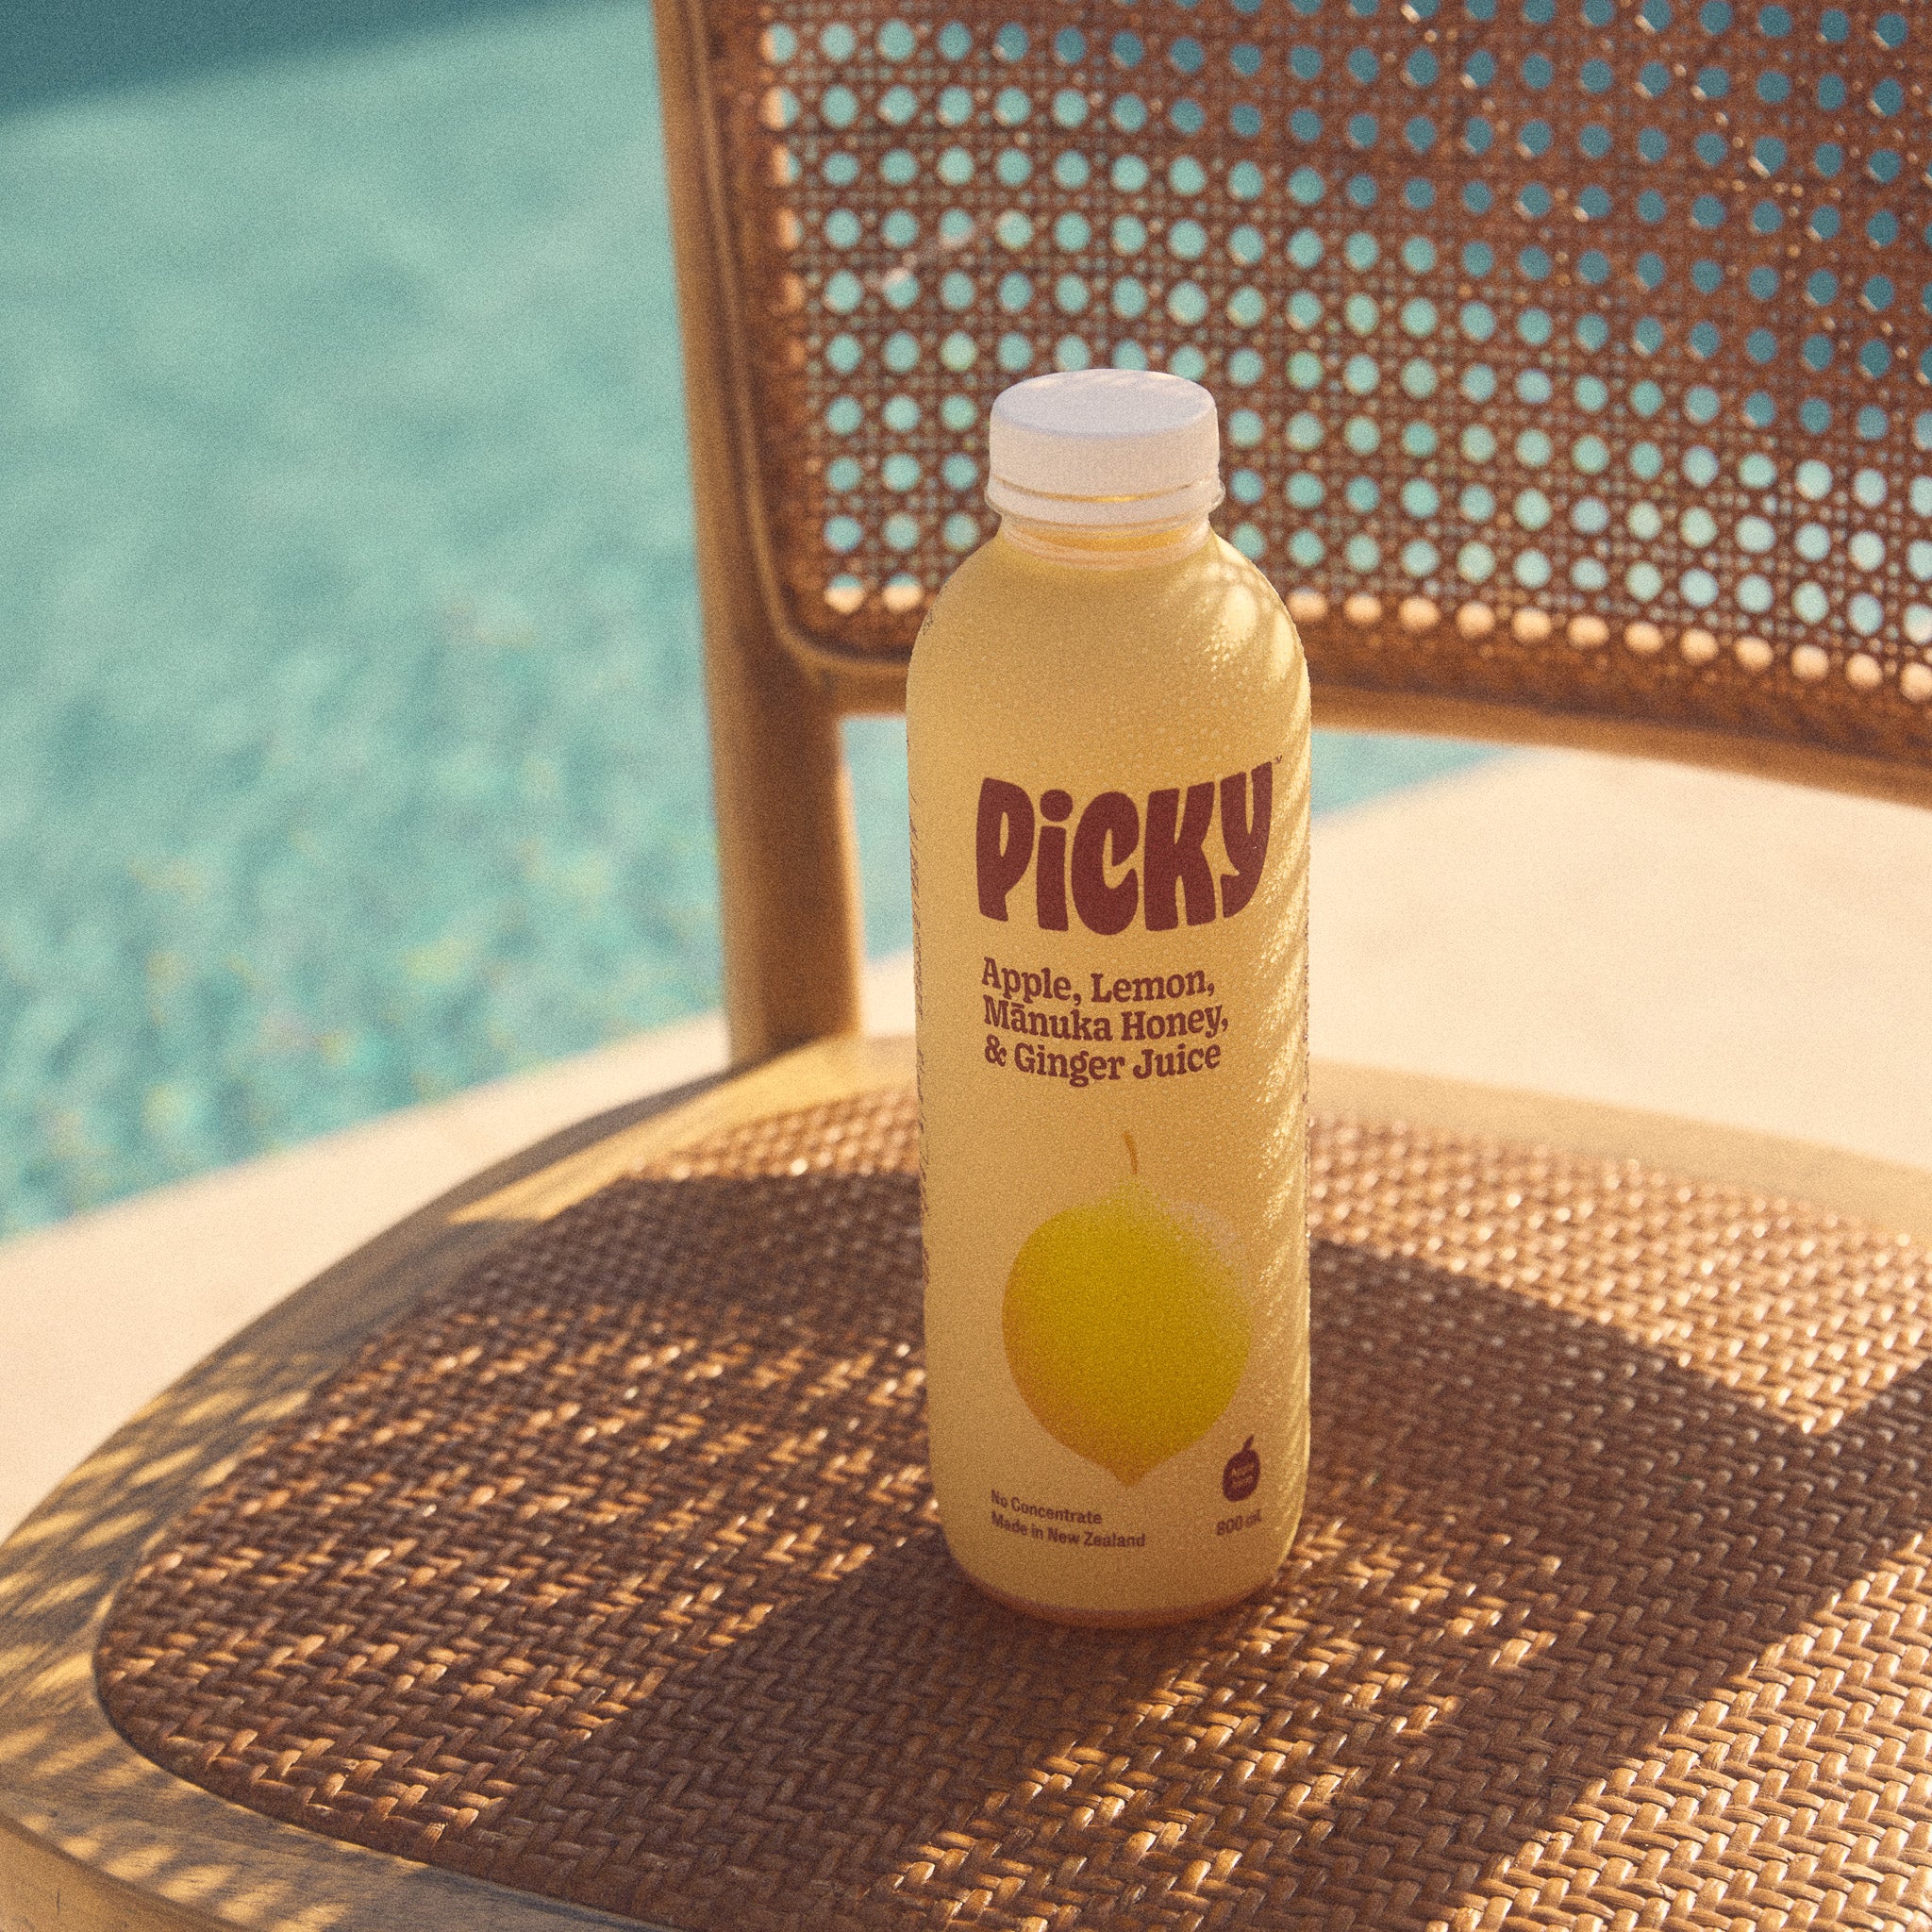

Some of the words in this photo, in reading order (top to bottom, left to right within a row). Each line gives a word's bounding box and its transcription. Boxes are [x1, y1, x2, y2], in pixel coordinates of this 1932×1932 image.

[982, 957, 1082, 1006] Apple,
[1091, 969, 1215, 1004] Lemon,
[983, 995, 1113, 1041] Mānuka
[1121, 1004, 1229, 1041] Honey,
[984, 1034, 1007, 1068] &
[1014, 1041, 1124, 1088] Ginger
[1132, 1043, 1222, 1080] Juice
[991, 1490, 1008, 1507] No
[1011, 1496, 1103, 1524] Concentrate
[991, 1511, 1027, 1536] Made
[1031, 1523, 1044, 1540] in
[1047, 1526, 1080, 1545] New
[1084, 1531, 1145, 1547] Zealand
